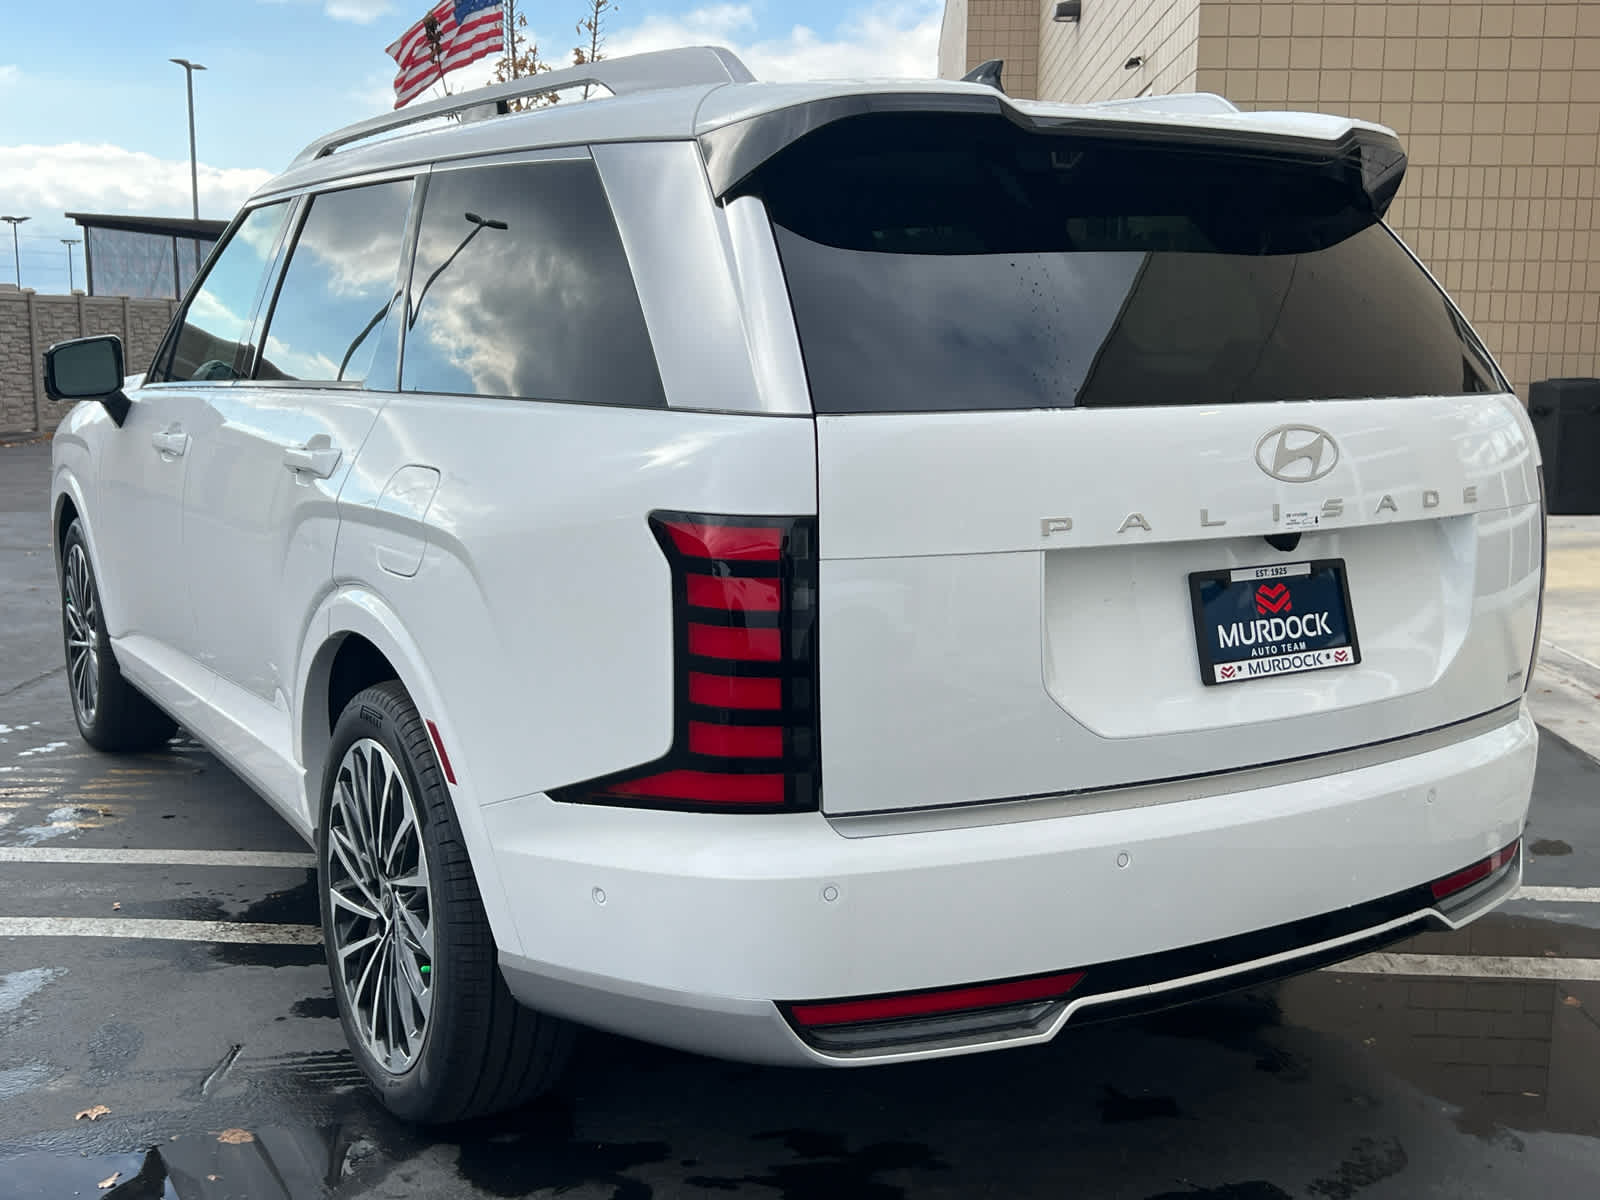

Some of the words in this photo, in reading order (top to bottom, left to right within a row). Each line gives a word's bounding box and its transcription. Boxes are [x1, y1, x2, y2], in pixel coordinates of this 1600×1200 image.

[1040, 486, 1479, 537] PALISADE
[1255, 568, 1270, 578] EST.
[1271, 567, 1288, 576] 1925
[1217, 611, 1333, 648] MURDOCK
[1251, 644, 1279, 657] AUTO
[1281, 641, 1307, 654] TEAM
[1247, 653, 1324, 676] MURDOCK
